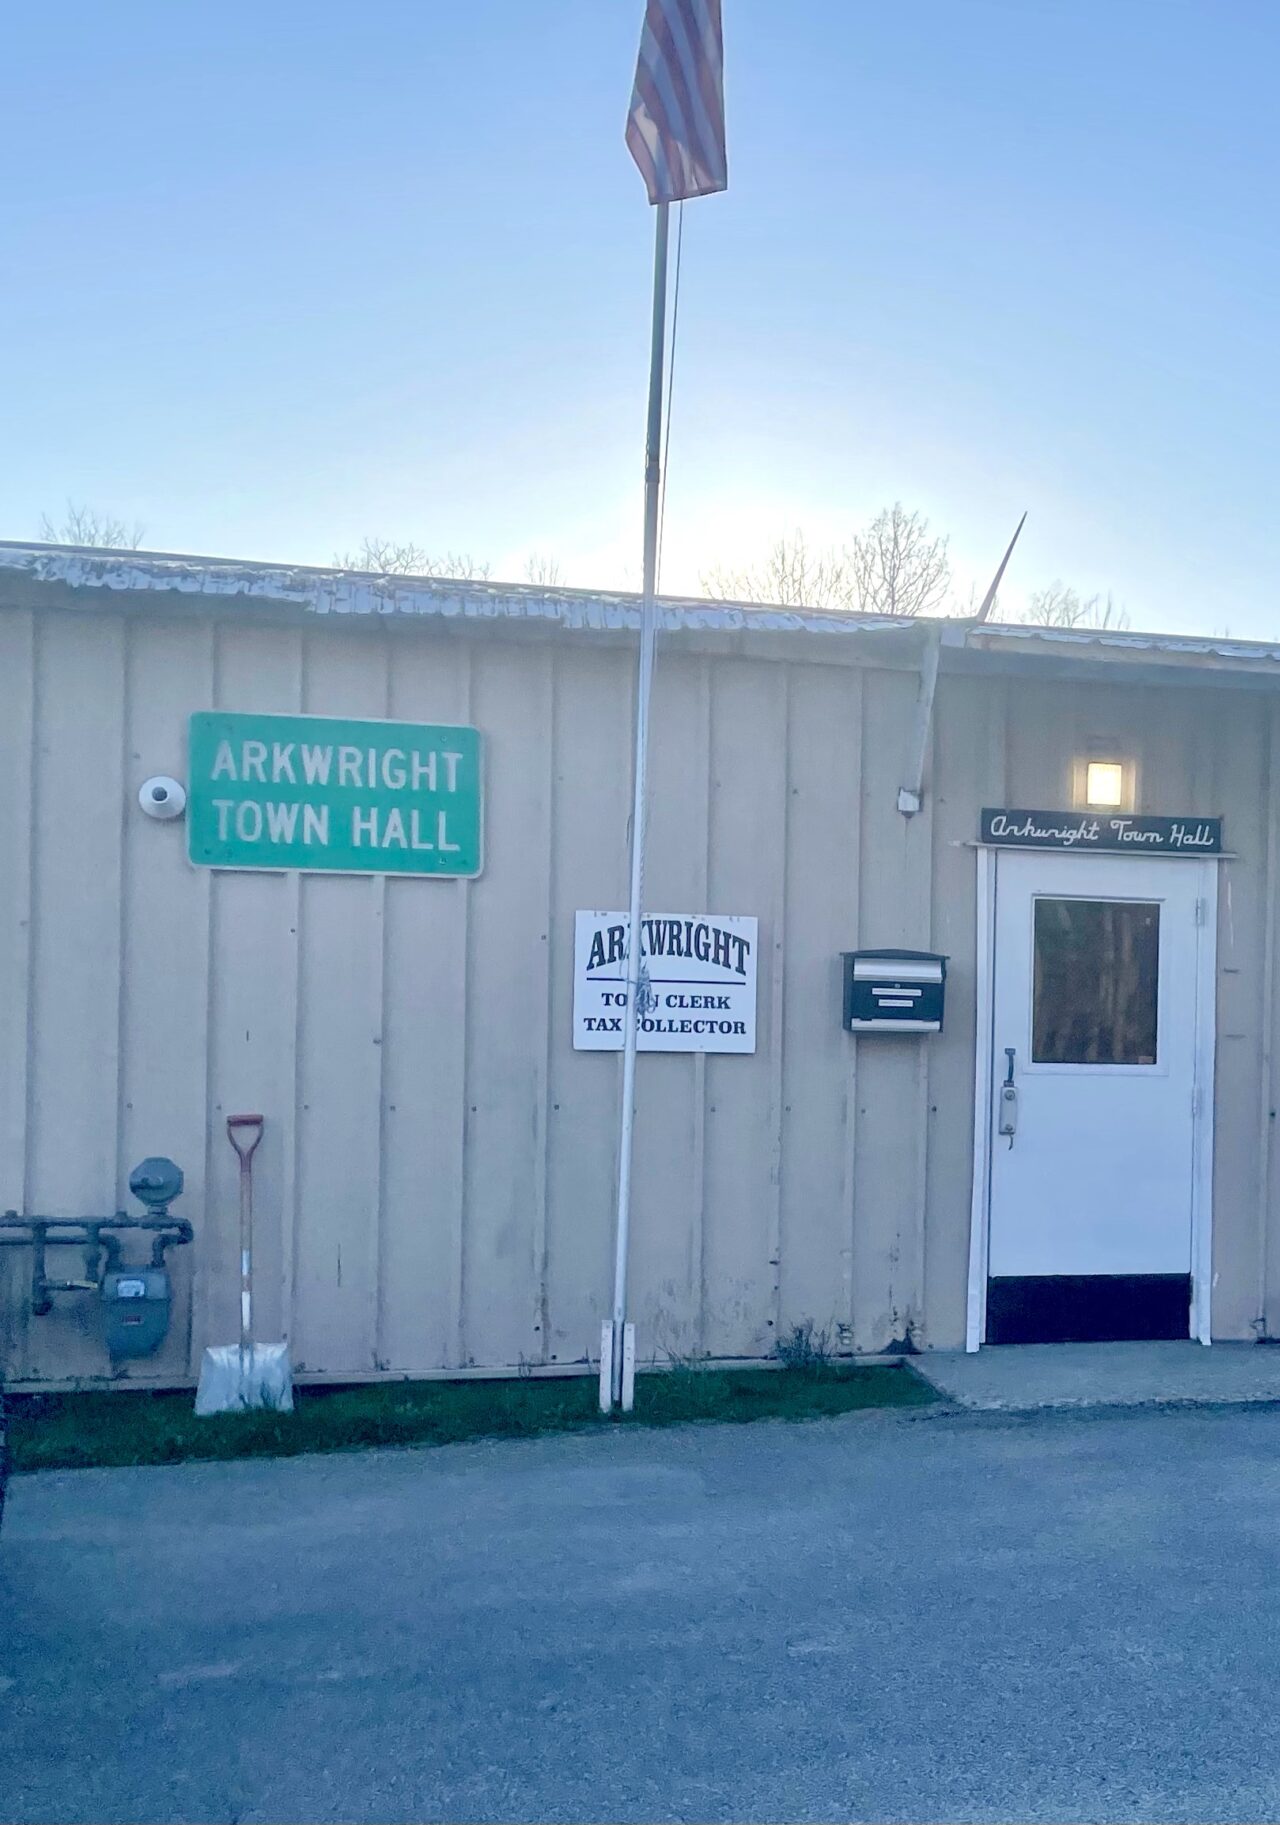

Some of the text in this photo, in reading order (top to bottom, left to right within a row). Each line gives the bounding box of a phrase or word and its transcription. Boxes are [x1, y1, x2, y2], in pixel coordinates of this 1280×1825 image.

[210, 739, 464, 793] ARKWRIGHT
[211, 799, 461, 852] TOWN HALL
[990, 815, 1214, 847] Arkwright Town Hall
[601, 992, 731, 1010] TO CLERK
[583, 1018, 622, 1032] TAX
